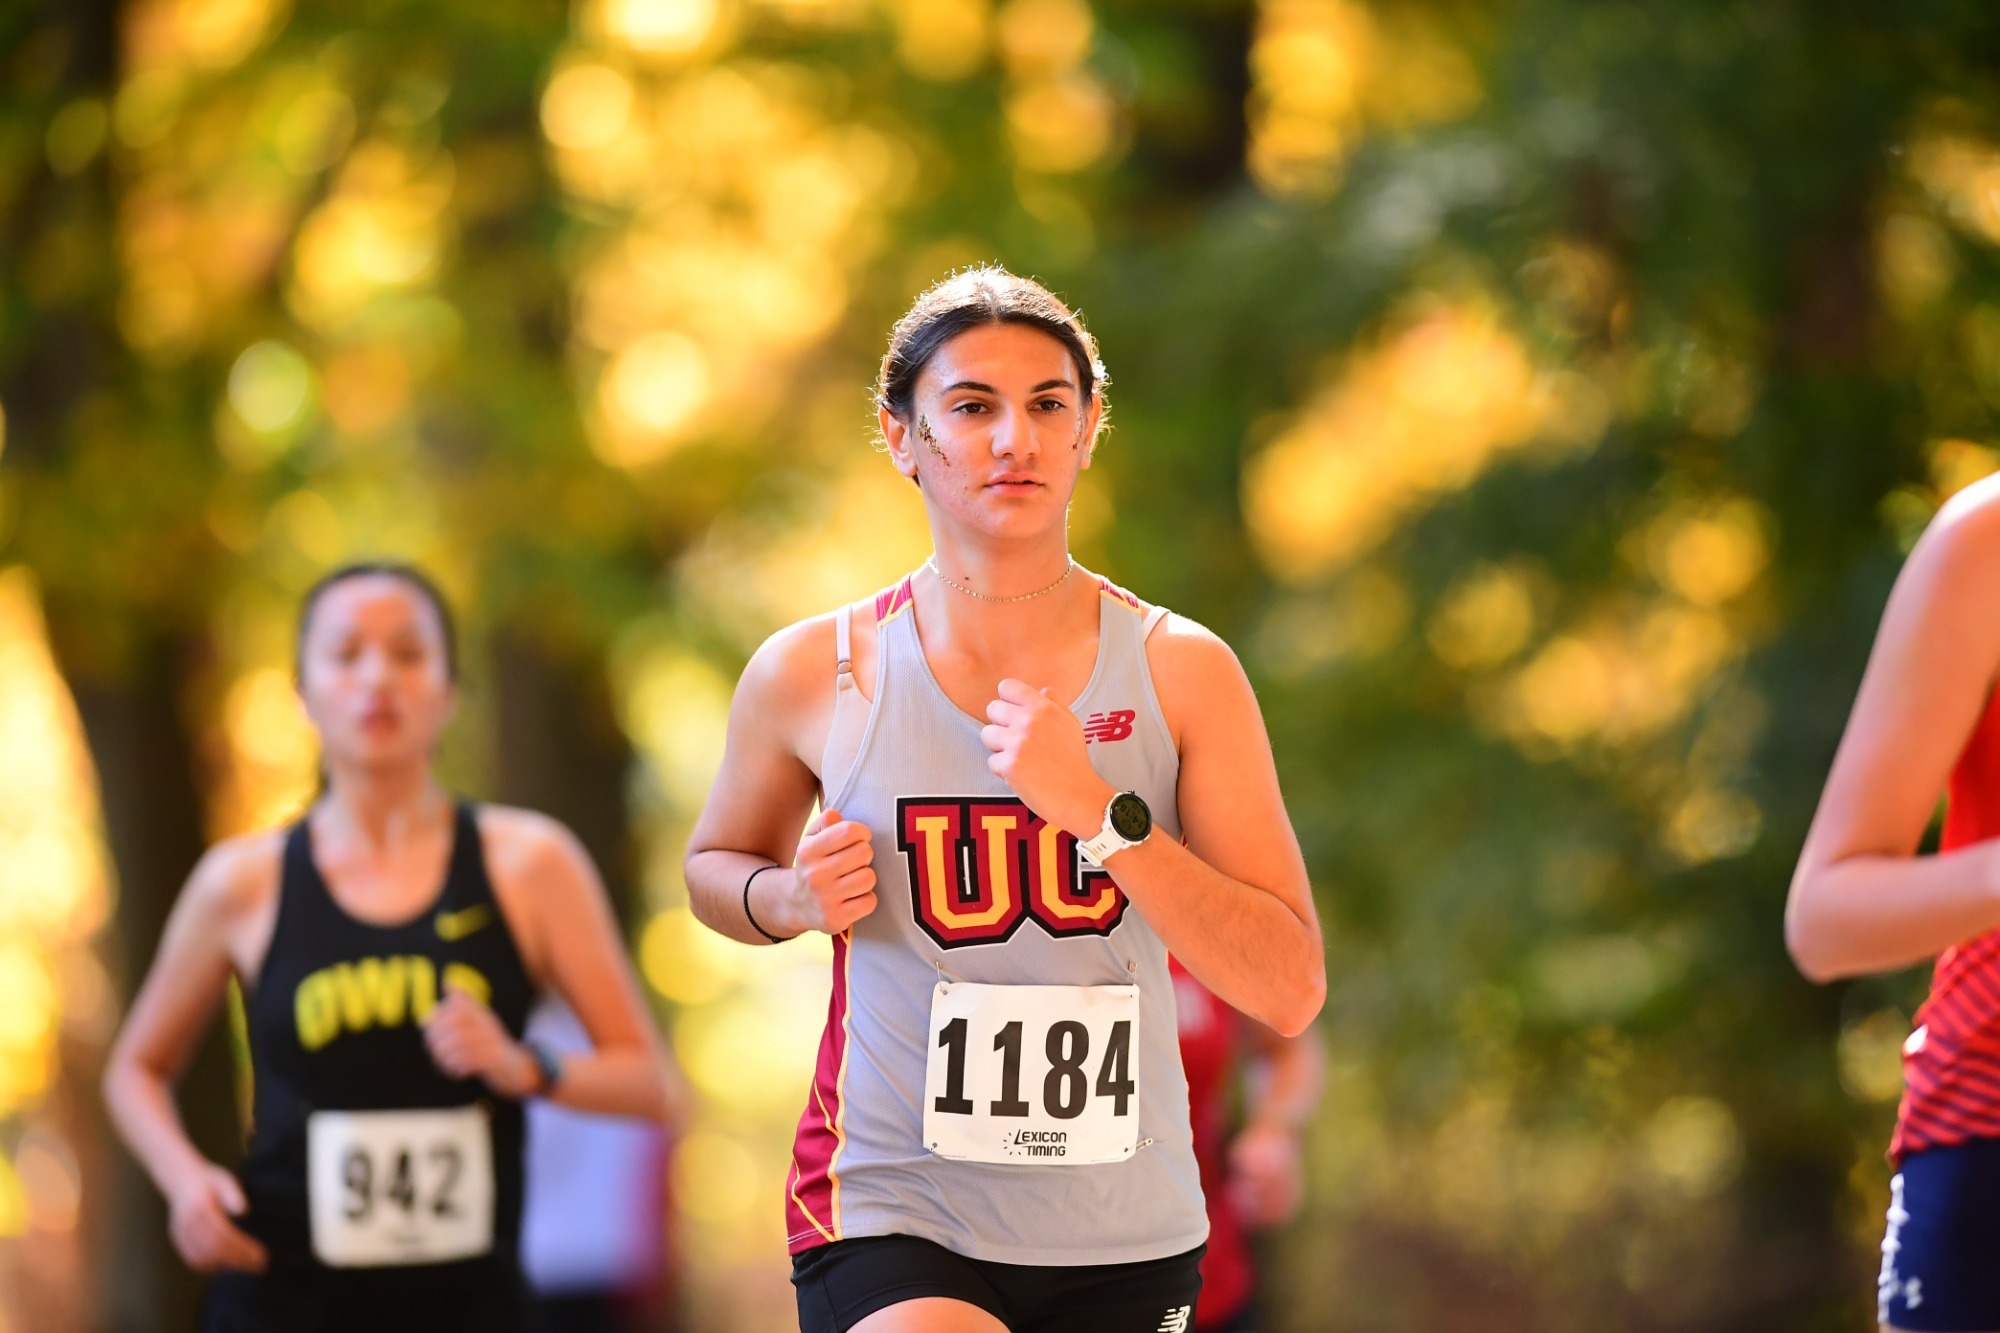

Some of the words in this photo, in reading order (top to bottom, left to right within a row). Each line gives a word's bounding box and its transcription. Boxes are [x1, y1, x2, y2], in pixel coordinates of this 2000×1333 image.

[895, 796, 1130, 951] UC
[934, 1017, 1135, 1119] 1184
[1013, 1128, 1067, 1145] LEXICON
[1021, 1145, 1067, 1157] TIMING
[340, 1142, 465, 1222] 942
